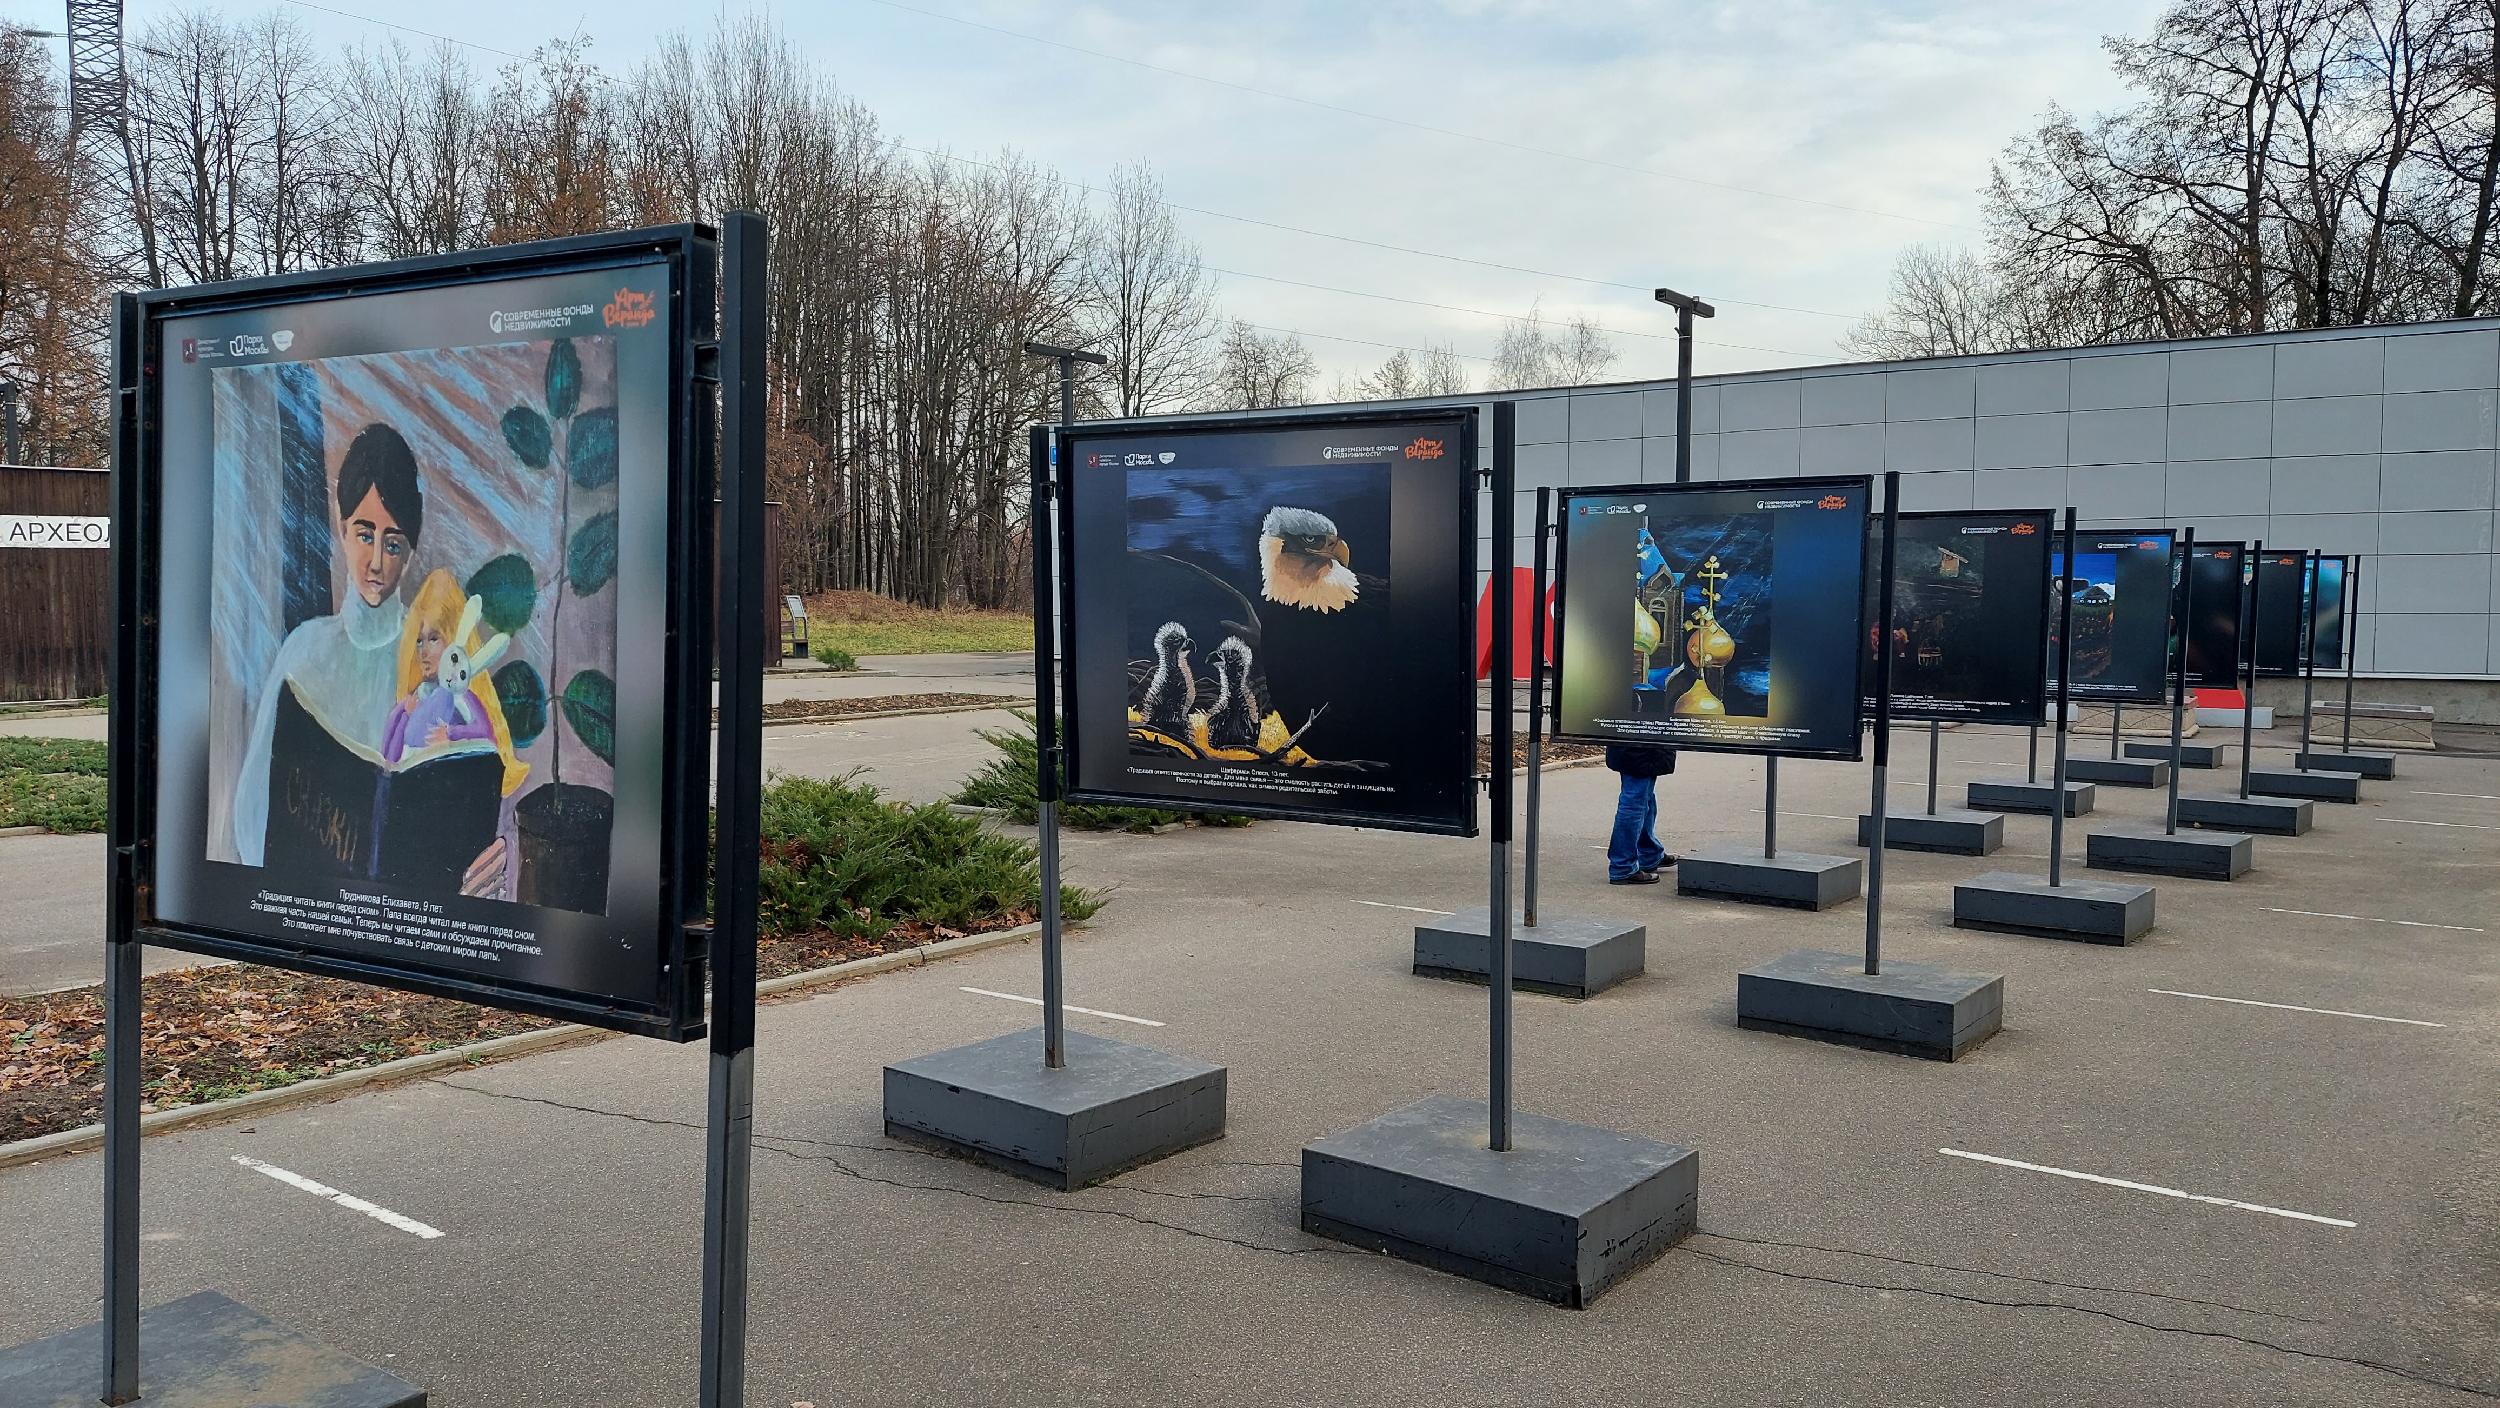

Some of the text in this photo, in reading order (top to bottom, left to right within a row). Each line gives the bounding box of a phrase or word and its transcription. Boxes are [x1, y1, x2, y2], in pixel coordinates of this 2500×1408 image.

[503, 304, 595, 322] СОВРЕМЕННЫЕ ФОНДЫ
[504, 316, 571, 332] НЕДВИЖИМОСТИ
[243, 335, 263, 348] Парки
[244, 343, 269, 356] Москвы
[339, 888, 444, 914] Прудникова Елизавета, 9 лет.
[257, 889, 293, 904] «Традиция
[293, 896, 316, 908] читать
[316, 899, 336, 911] книги
[335, 902, 357, 915] перед
[383, 907, 402, 920] Папа
[403, 912, 428, 926] всегда
[428, 916, 450, 928] читал
[451, 919, 467, 930] мне
[467, 922, 489, 934] книги
[489, 926, 514, 940] перед
[514, 930, 536, 942] сном.
[250, 899, 544, 956] Это важная часть нашей семьи. Теперь мы читаем сами и обсуждаем прочитанное.
[282, 917, 501, 962] Это помогает мне почувствовать связь с детским миром папы.
